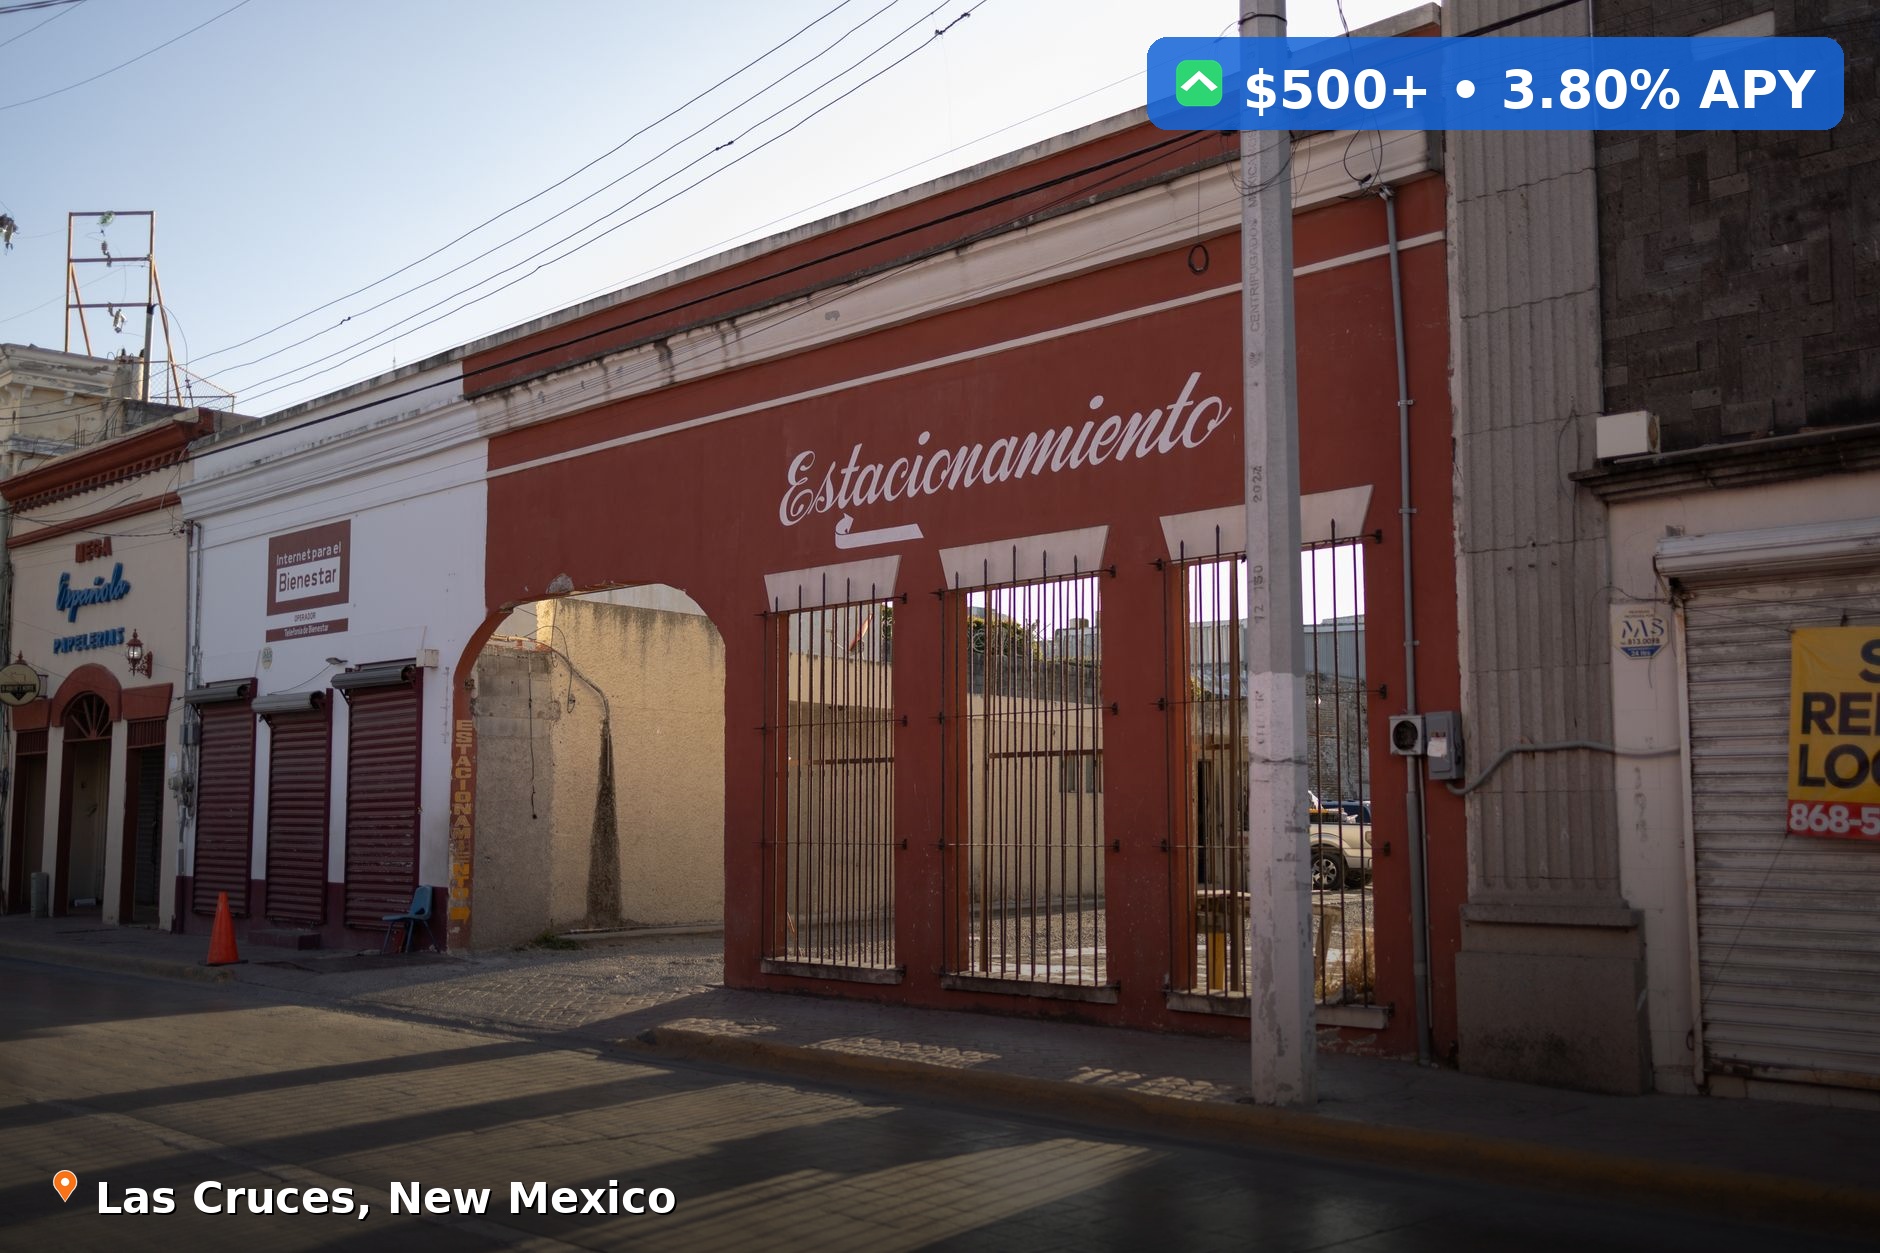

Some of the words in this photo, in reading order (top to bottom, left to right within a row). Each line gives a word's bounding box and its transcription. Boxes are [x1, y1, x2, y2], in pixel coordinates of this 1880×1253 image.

[779, 371, 1232, 527] Estacionamiento
[276, 548, 311, 566] Internet
[312, 546, 332, 561] para
[333, 541, 342, 554] el
[279, 568, 337, 592] Bienestar
[294, 612, 316, 623] OPERADOR
[1801, 692, 1880, 735] RE
[452, 719, 473, 899] ESTACIONAMIENTO
